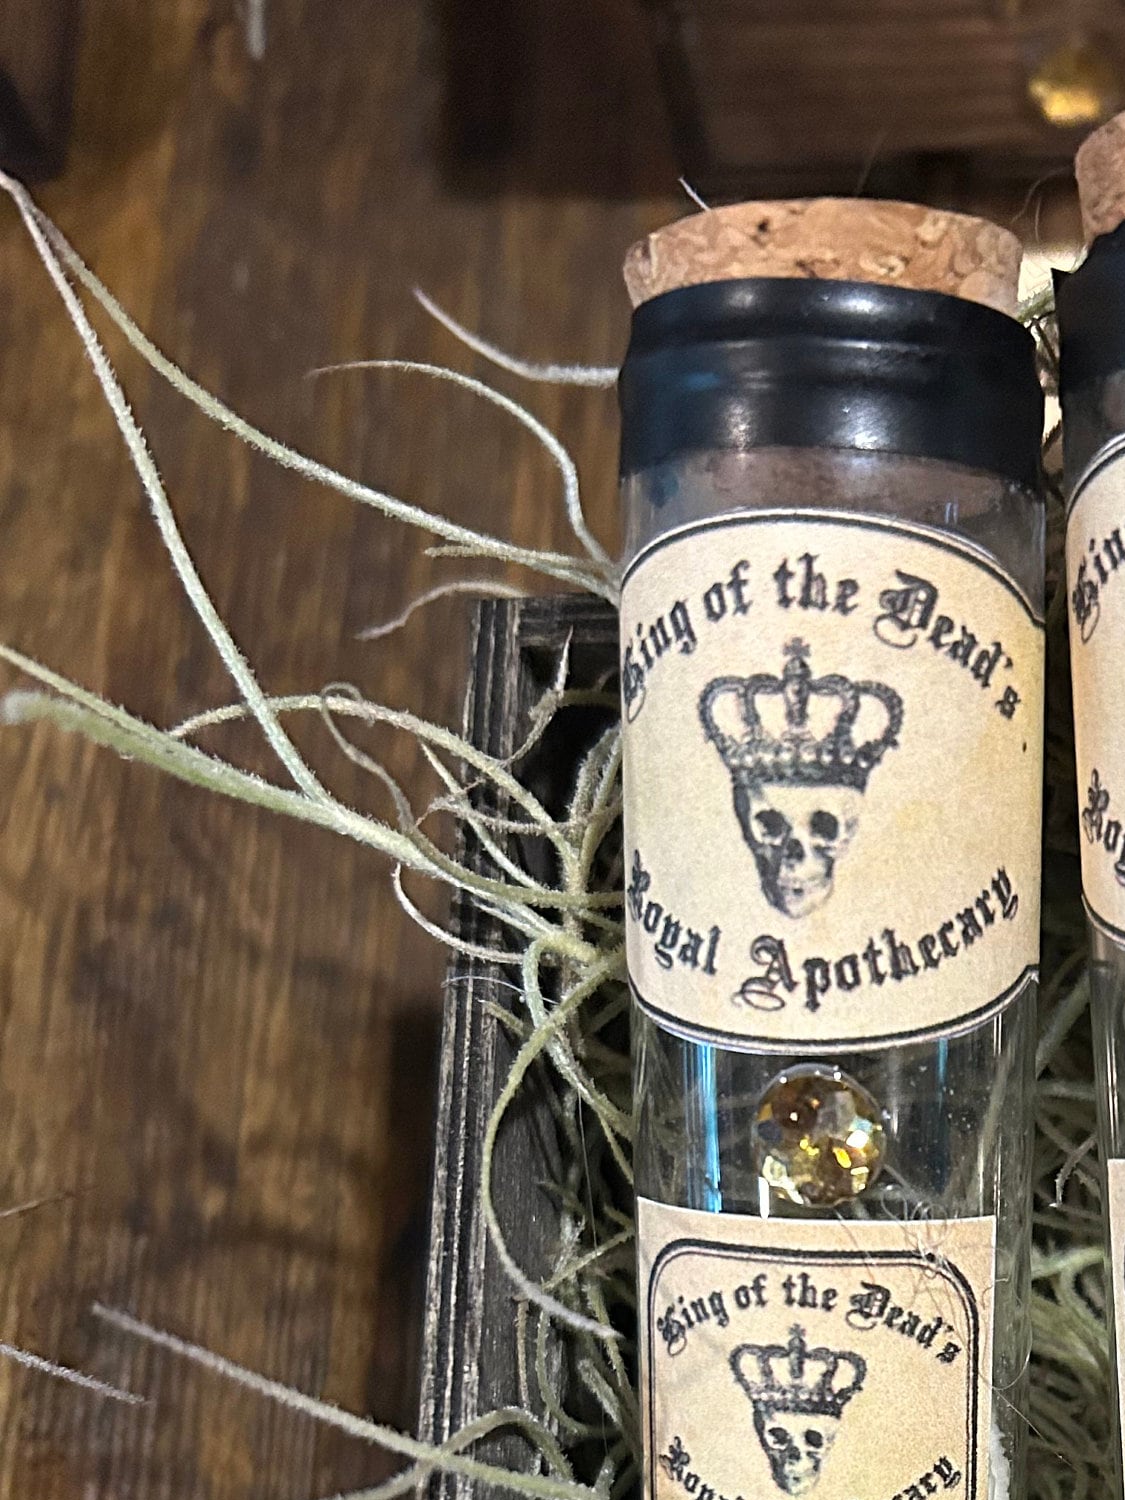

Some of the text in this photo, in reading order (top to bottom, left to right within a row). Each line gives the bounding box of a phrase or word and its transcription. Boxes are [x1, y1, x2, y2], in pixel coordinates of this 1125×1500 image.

[705, 560, 750, 622] of
[773, 552, 860, 616] the
[873, 569, 1022, 719] Dead's
[627, 849, 1019, 1012] Royal Apothecary
[657, 1273, 962, 1364] King of the Dead's
